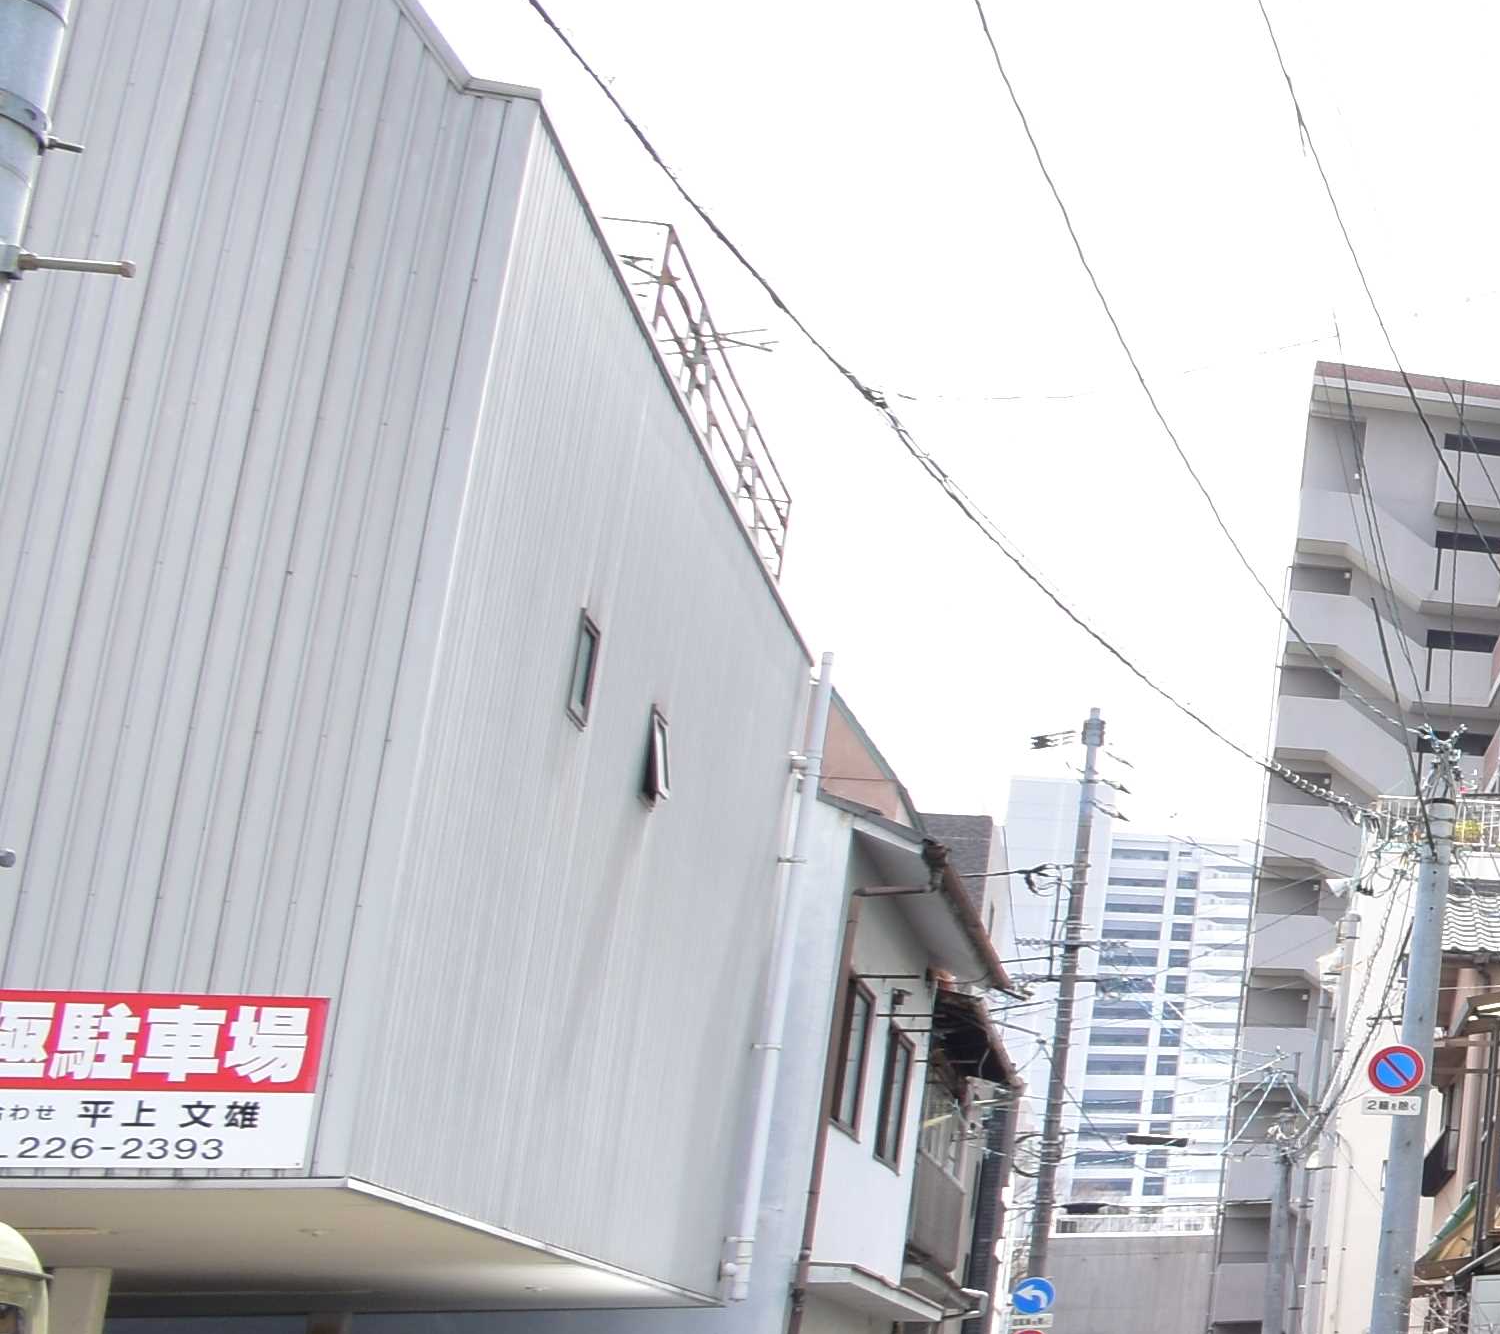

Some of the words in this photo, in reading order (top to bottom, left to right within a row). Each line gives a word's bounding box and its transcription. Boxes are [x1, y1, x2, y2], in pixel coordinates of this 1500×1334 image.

[77, 1100, 156, 1129] 平上
[178, 1100, 260, 1130] 文雄
[17, 1136, 224, 1160] 226-2393
